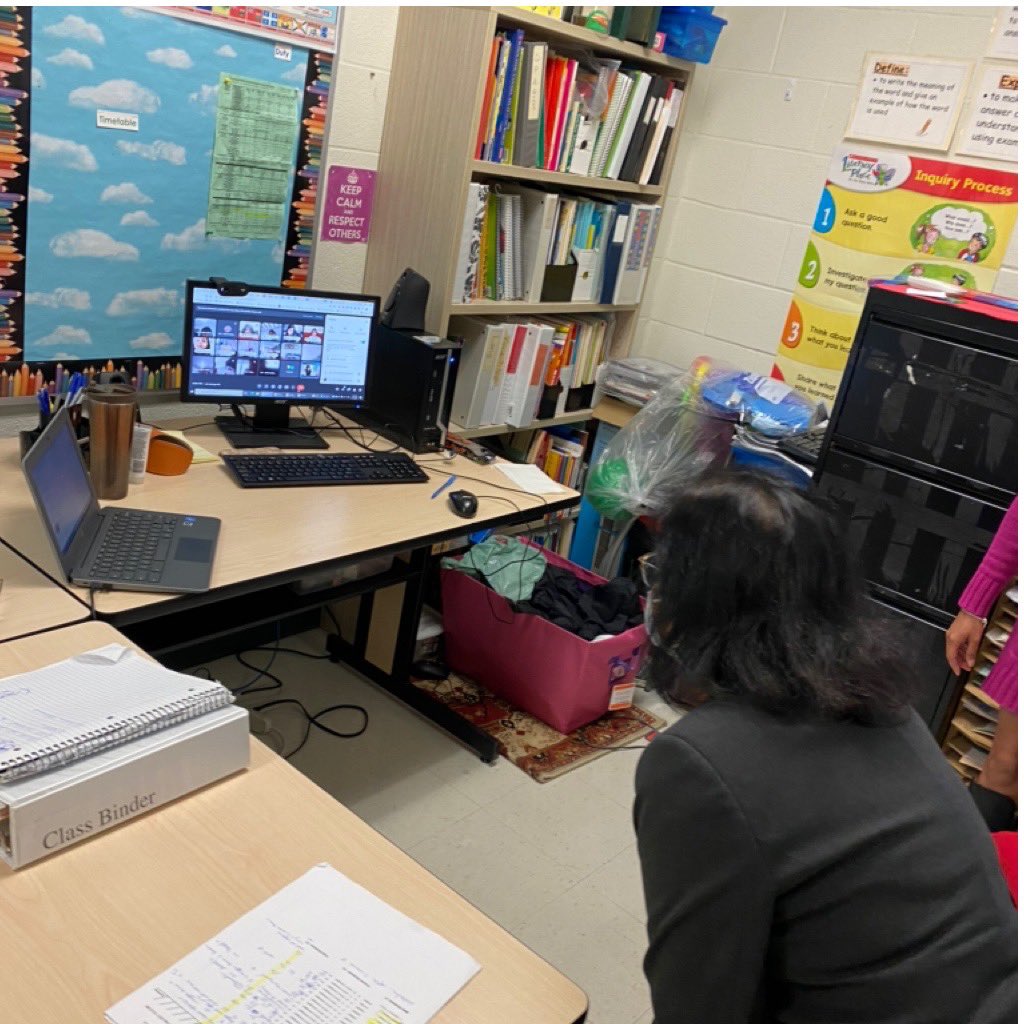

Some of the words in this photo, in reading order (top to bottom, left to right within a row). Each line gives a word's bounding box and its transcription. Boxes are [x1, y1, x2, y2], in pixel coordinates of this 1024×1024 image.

[874, 61, 909, 76] Define:
[872, 87, 883, 95] the
[884, 88, 900, 97] word
[906, 80, 917, 88] the
[919, 82, 945, 91] meaning
[946, 83, 956, 91] of
[919, 102, 930, 111] the
[931, 104, 950, 113] word
[980, 106, 1013, 117] answer
[99, 114, 137, 128] Timetable
[971, 133, 995, 145] using
[340, 184, 362, 195] KEEP
[914, 169, 960, 190] Inquiry
[963, 179, 1014, 197] Process
[336, 196, 362, 209] CALM
[328, 215, 365, 227] RESPECT
[821, 207, 831, 226] 1
[844, 207, 858, 217] Ask
[859, 211, 866, 219] a
[866, 212, 888, 224] good
[328, 228, 362, 239] OTHERS
[804, 260, 817, 280] 2
[788, 323, 800, 342] 3
[810, 325, 828, 337] Think
[829, 329, 851, 343] about
[807, 336, 824, 348] what
[825, 340, 839, 352] you
[42, 820, 94, 849] Class
[98, 791, 158, 826] Binder
